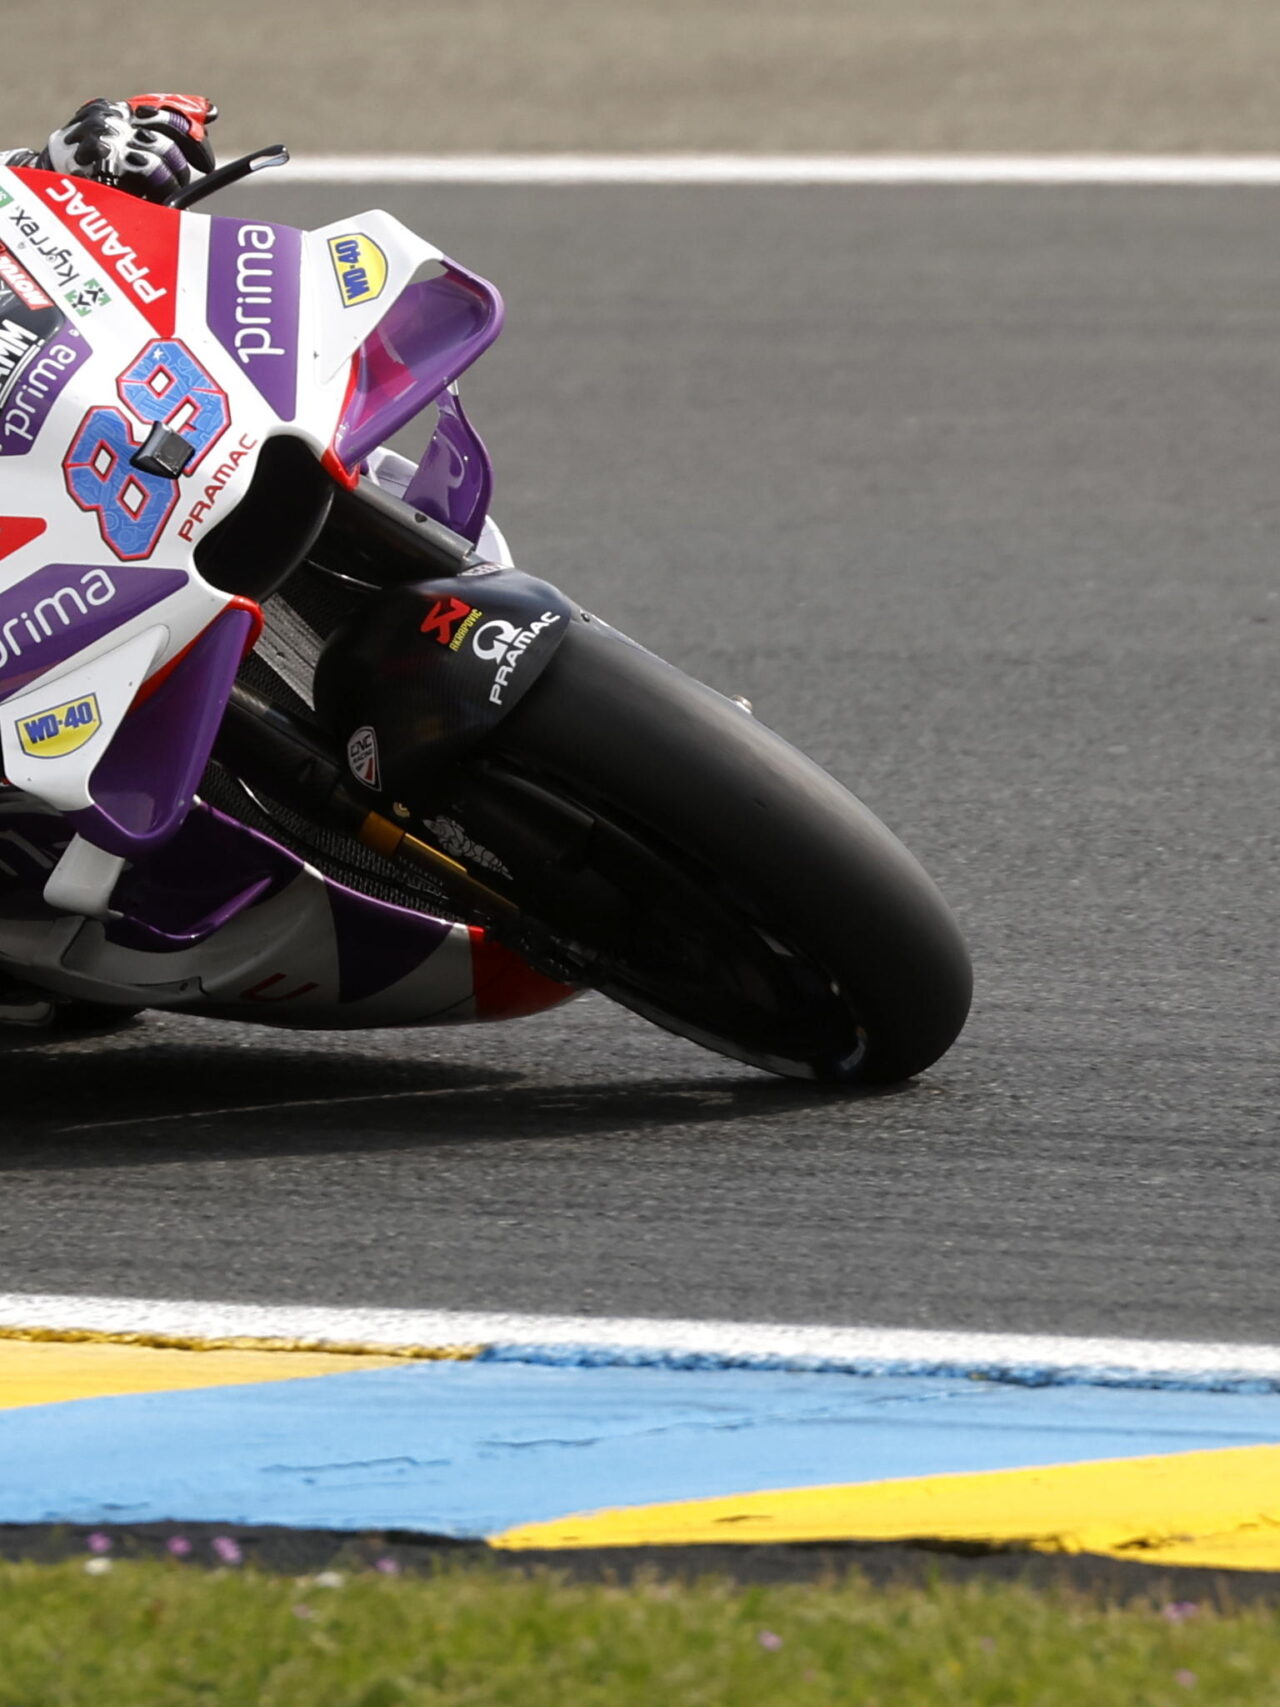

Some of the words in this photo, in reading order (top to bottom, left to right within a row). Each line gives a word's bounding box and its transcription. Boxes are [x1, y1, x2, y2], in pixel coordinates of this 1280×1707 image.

[9, 208, 80, 287] kyrrex
[45, 178, 167, 304] PRAMAC
[335, 239, 370, 301] WD-40
[234, 223, 285, 364] prima
[4, 344, 77, 440] prima
[63, 338, 232, 562] 89
[177, 433, 258, 542] PRAMAC
[489, 611, 561, 706] PRAMAC
[24, 702, 95, 744] WD-40
[350, 734, 373, 757] CNC
